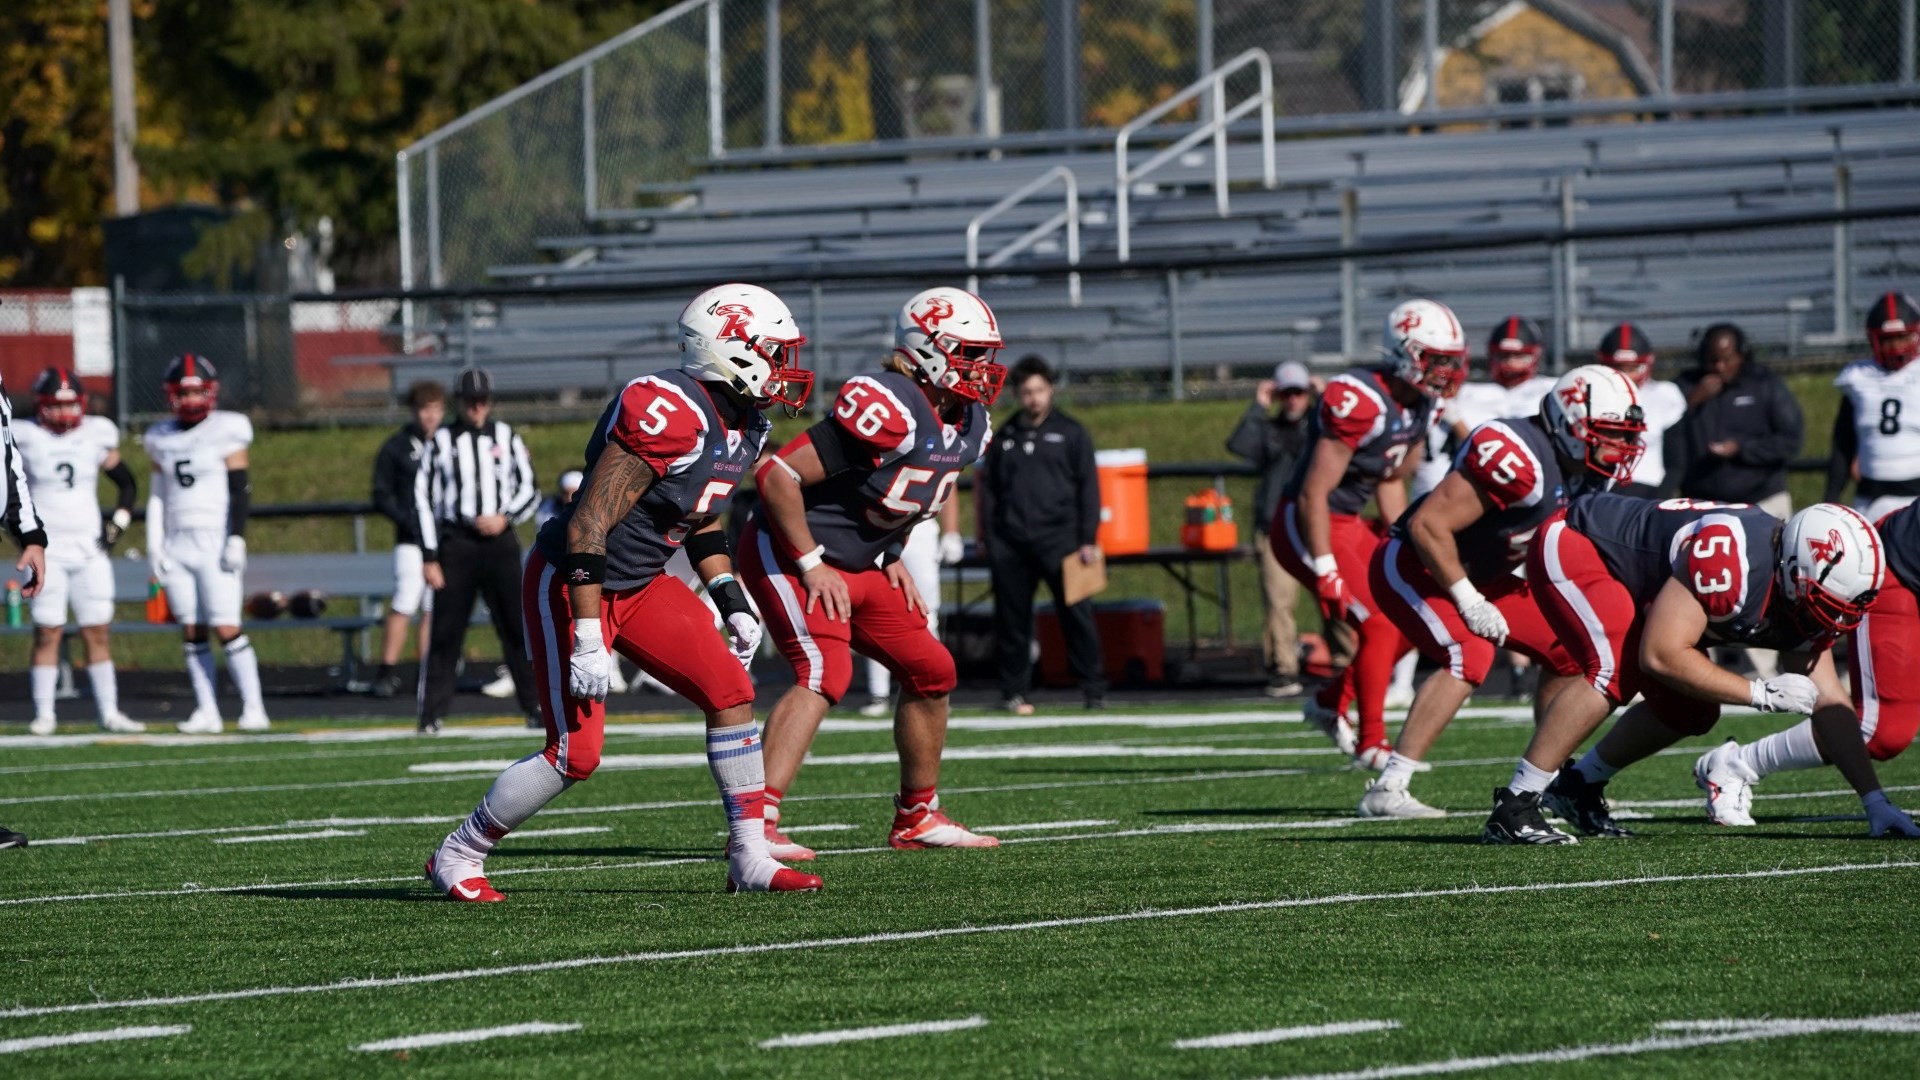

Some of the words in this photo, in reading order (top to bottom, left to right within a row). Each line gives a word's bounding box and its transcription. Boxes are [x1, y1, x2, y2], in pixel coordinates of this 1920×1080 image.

[638, 396, 679, 436] 5
[837, 386, 891, 437] 56
[1331, 390, 1359, 419] 3
[1879, 398, 1902, 435] 8
[56, 461, 75, 489] 3
[713, 461, 724, 471] RED
[1477, 439, 1526, 485] 45
[1693, 535, 1732, 595] 53
